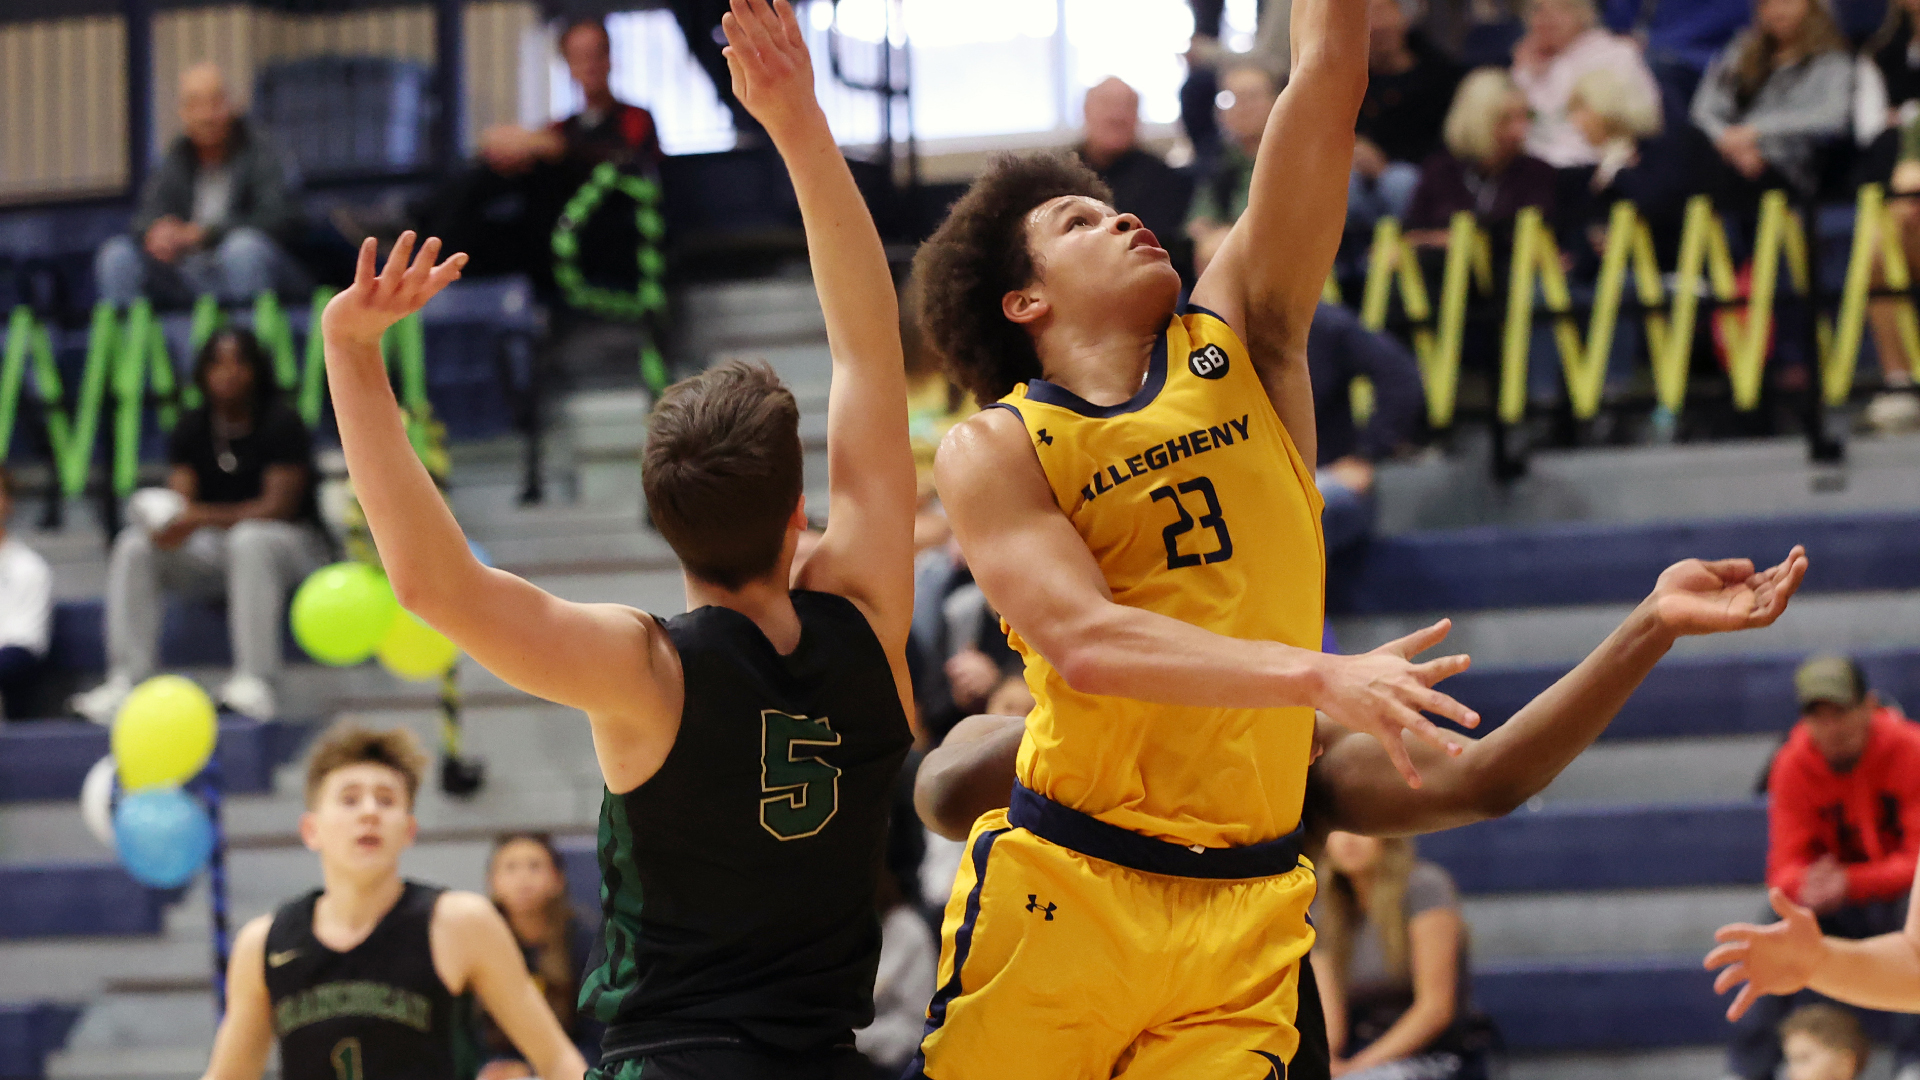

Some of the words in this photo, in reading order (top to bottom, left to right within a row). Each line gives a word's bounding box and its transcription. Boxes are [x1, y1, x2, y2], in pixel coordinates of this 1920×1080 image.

[1192, 345, 1225, 376] GB
[1149, 476, 1233, 570] 23
[760, 709, 842, 841] 5
